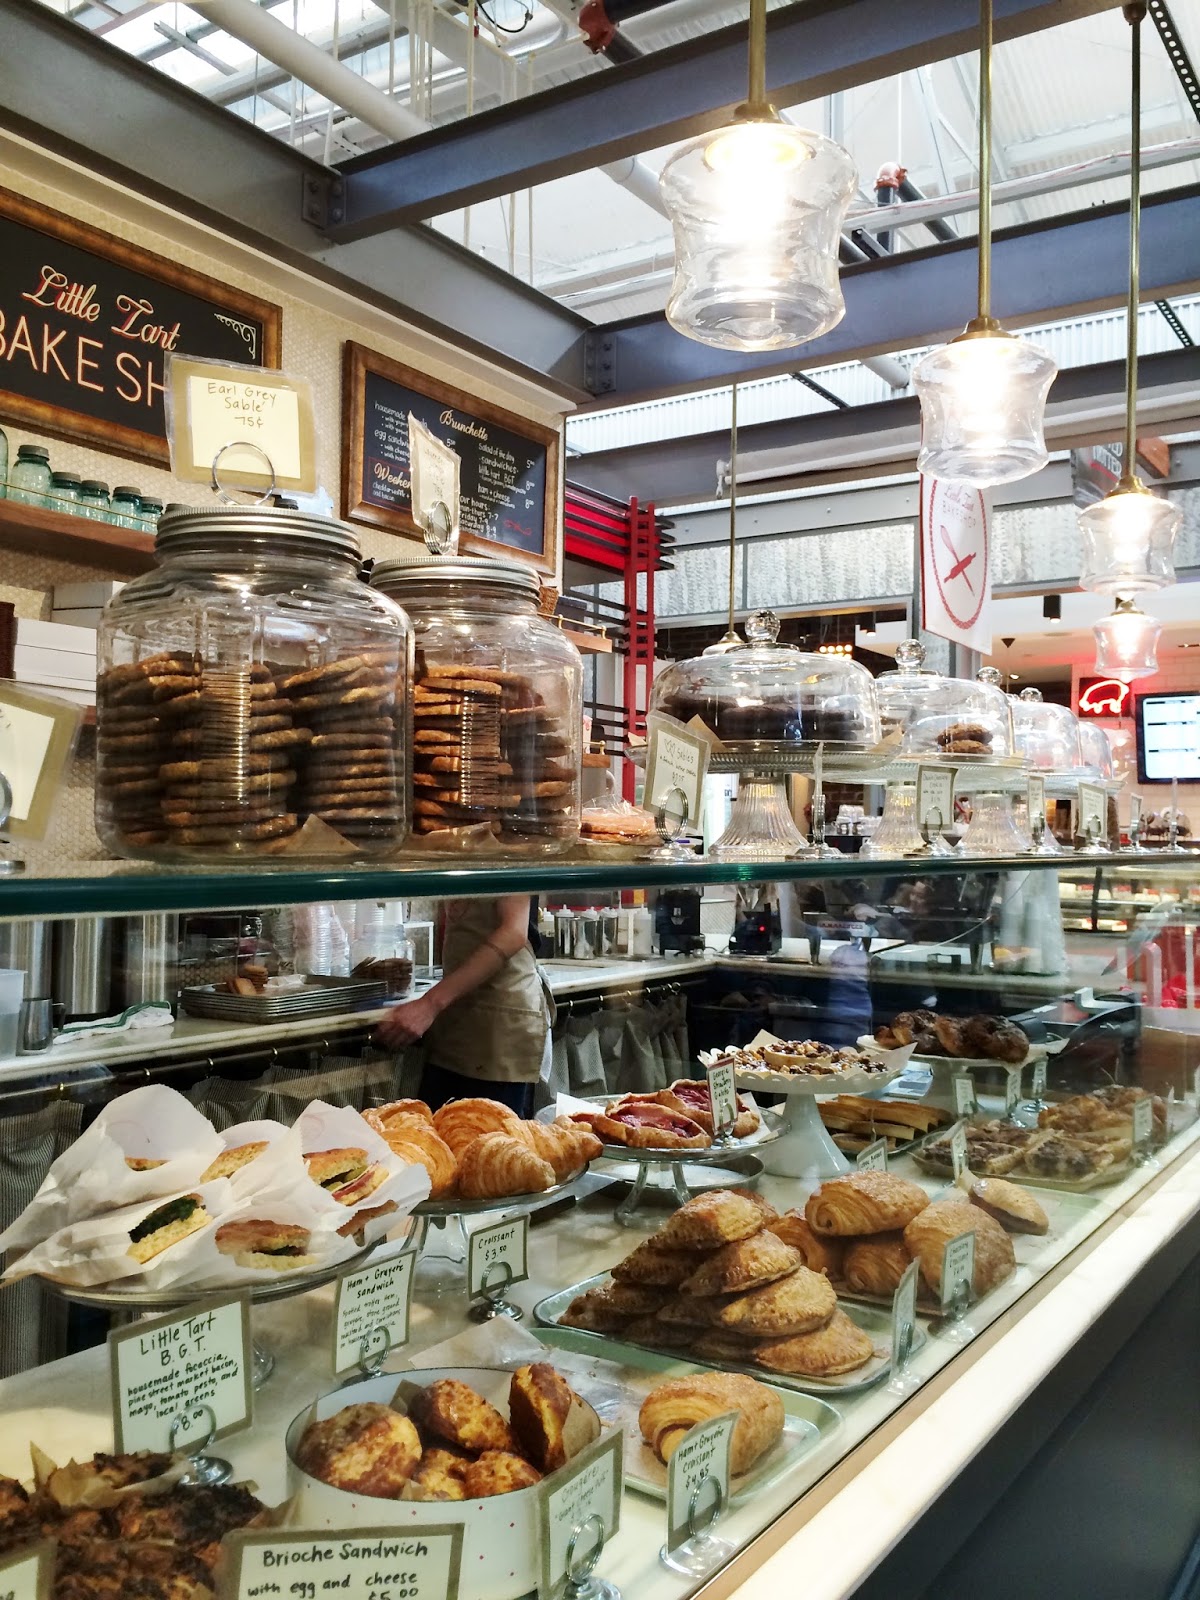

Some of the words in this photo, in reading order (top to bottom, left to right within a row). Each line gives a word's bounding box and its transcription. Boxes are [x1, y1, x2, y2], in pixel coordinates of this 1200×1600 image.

[22, 265, 100, 322] Little
[111, 294, 181, 350] Tart
[208, 382, 237, 396] Earl
[244, 386, 277, 407] Grey
[234, 416, 264, 429] 75¢
[374, 430, 386, 441] egg
[440, 410, 489, 441] Brunchette
[478, 1228, 515, 1249] Croissant
[347, 1278, 363, 1292] Ham
[357, 1277, 394, 1299] sandwich
[140, 1327, 180, 1356] Little
[183, 1312, 217, 1339] Tart
[128, 1368, 180, 1397] housemade
[128, 1394, 146, 1408] pine
[149, 1383, 174, 1399] street
[177, 1369, 209, 1388] market
[211, 1360, 238, 1374] bacon,
[129, 1403, 157, 1418] mayo,
[160, 1390, 189, 1405] tomato
[194, 1378, 218, 1395] pesto,
[221, 1367, 239, 1381] and
[156, 1404, 178, 1419] local
[185, 1390, 216, 1408] greens
[678, 1445, 694, 1462] Ham
[263, 1544, 334, 1568] Brioche
[339, 1540, 428, 1560] Sandwich
[247, 1583, 281, 1597] with
[290, 1582, 316, 1599] egg
[322, 1574, 351, 1590] and
[365, 1571, 418, 1587] cheese
